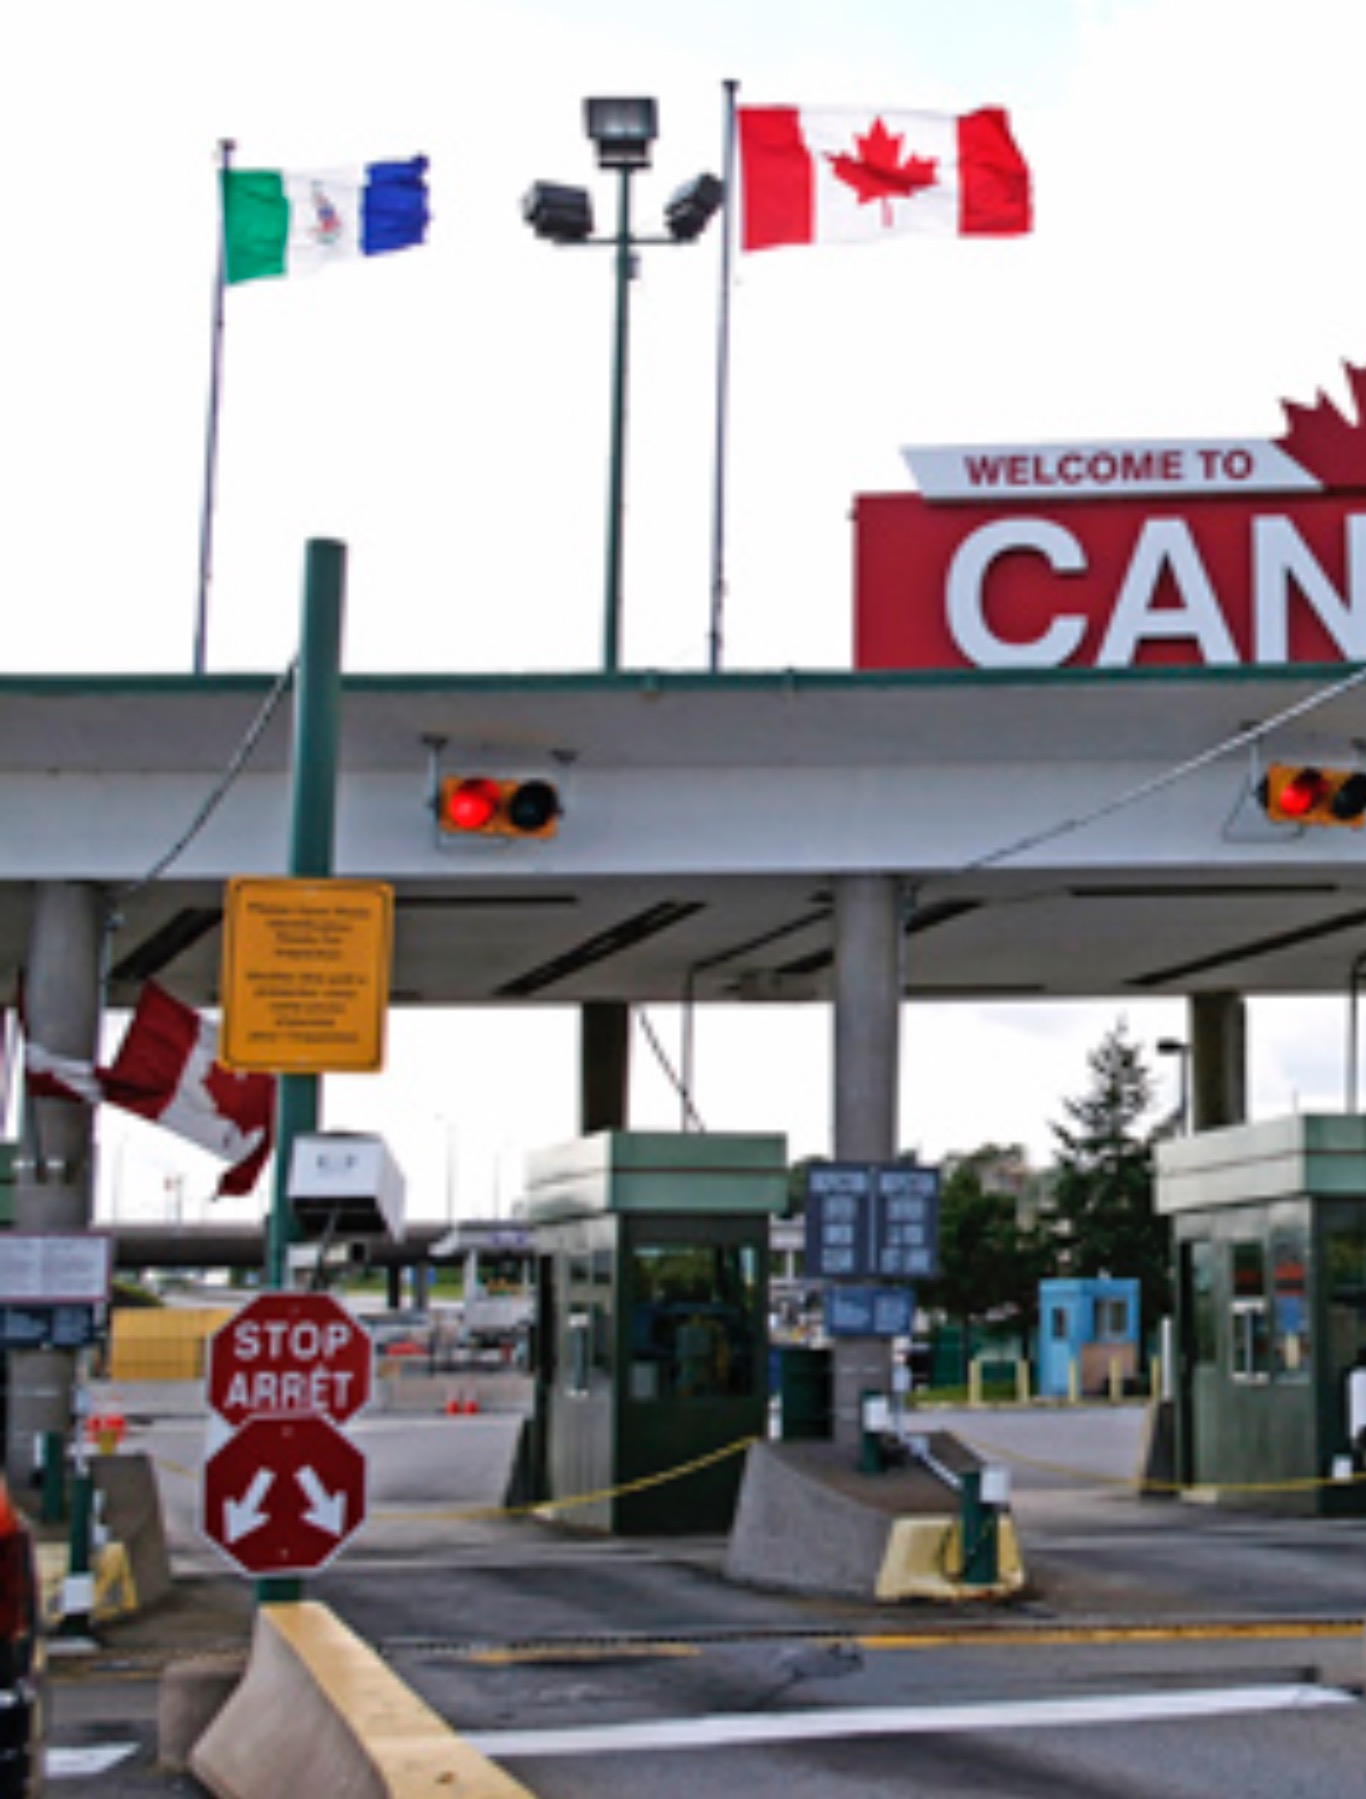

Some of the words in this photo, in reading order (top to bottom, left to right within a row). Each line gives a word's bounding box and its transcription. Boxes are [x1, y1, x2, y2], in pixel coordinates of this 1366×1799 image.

[965, 450, 1182, 485] WELCOME
[1197, 448, 1254, 480] TO
[233, 1320, 350, 1361] STOP
[224, 1364, 353, 1410] ARRÊT
